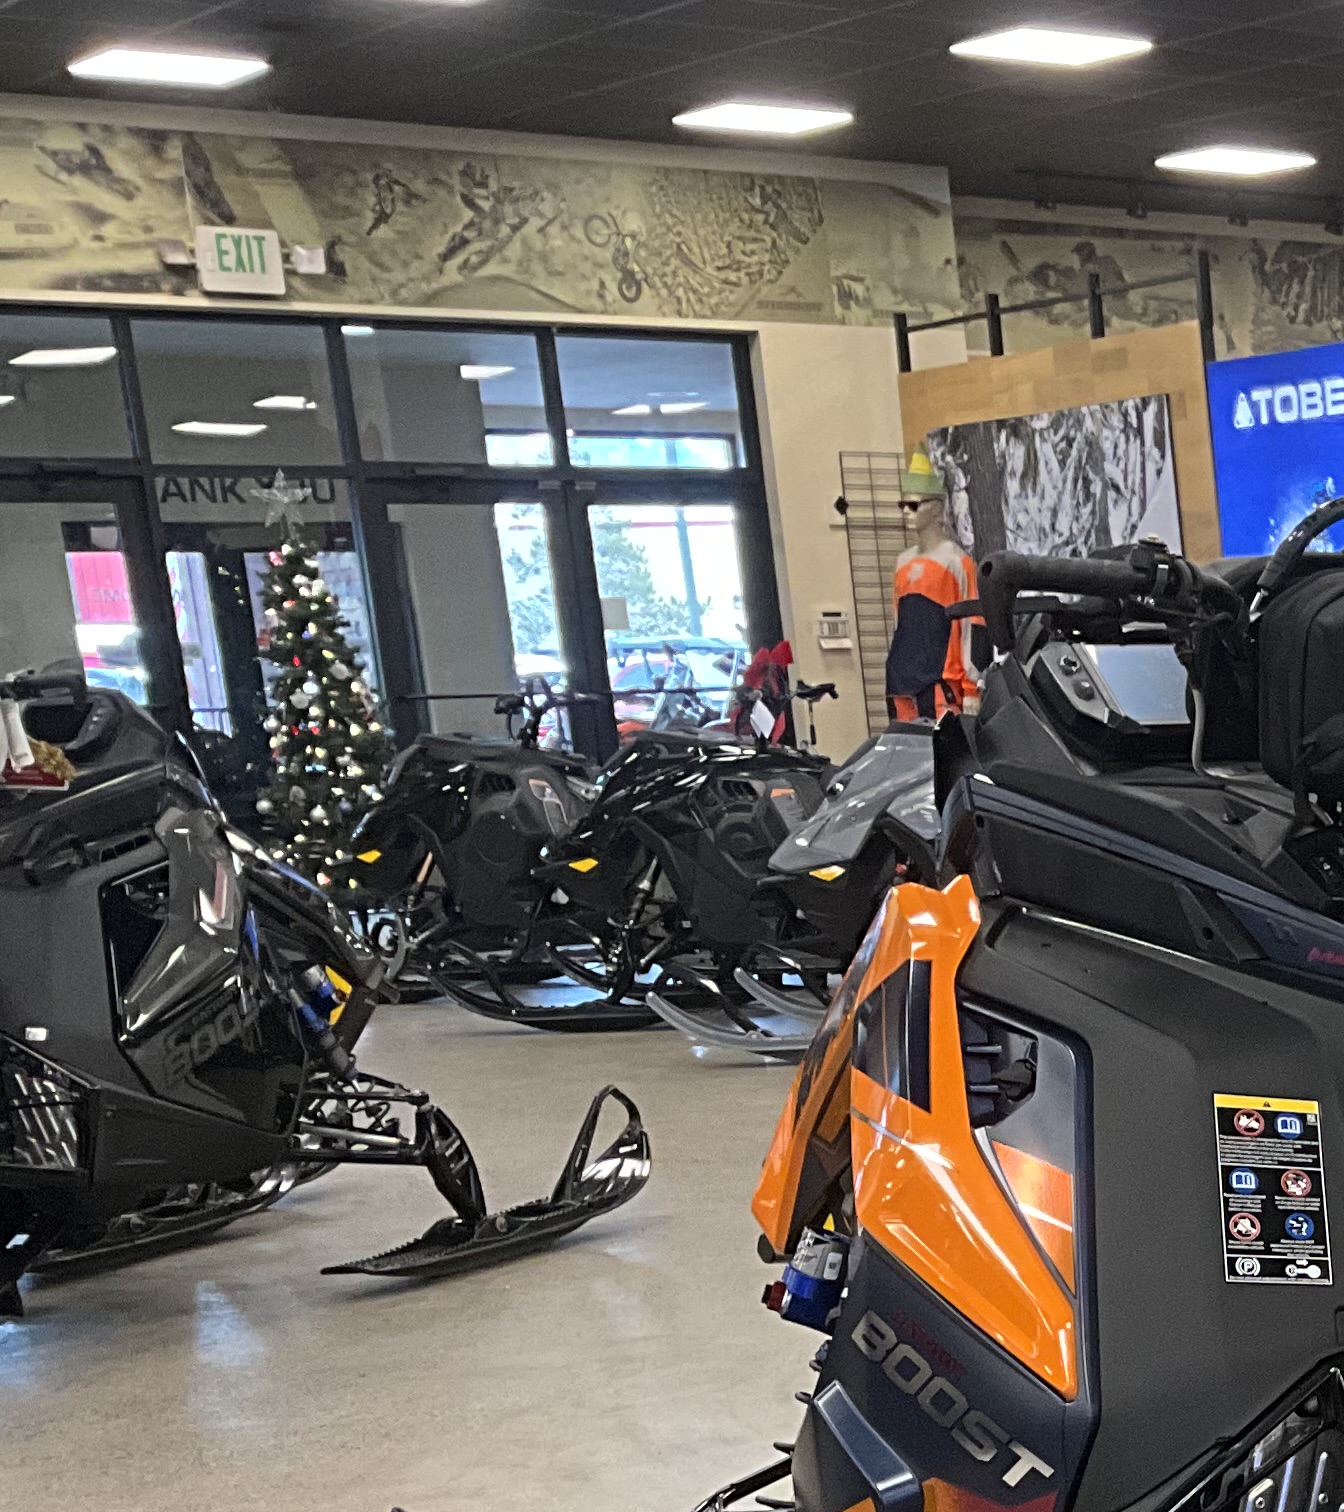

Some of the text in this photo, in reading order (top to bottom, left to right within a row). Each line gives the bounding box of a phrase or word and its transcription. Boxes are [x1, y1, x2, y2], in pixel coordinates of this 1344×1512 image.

[214, 232, 266, 274] EXIT
[159, 473, 337, 505] ANK YU
[850, 1308, 1056, 1488] BOOST
